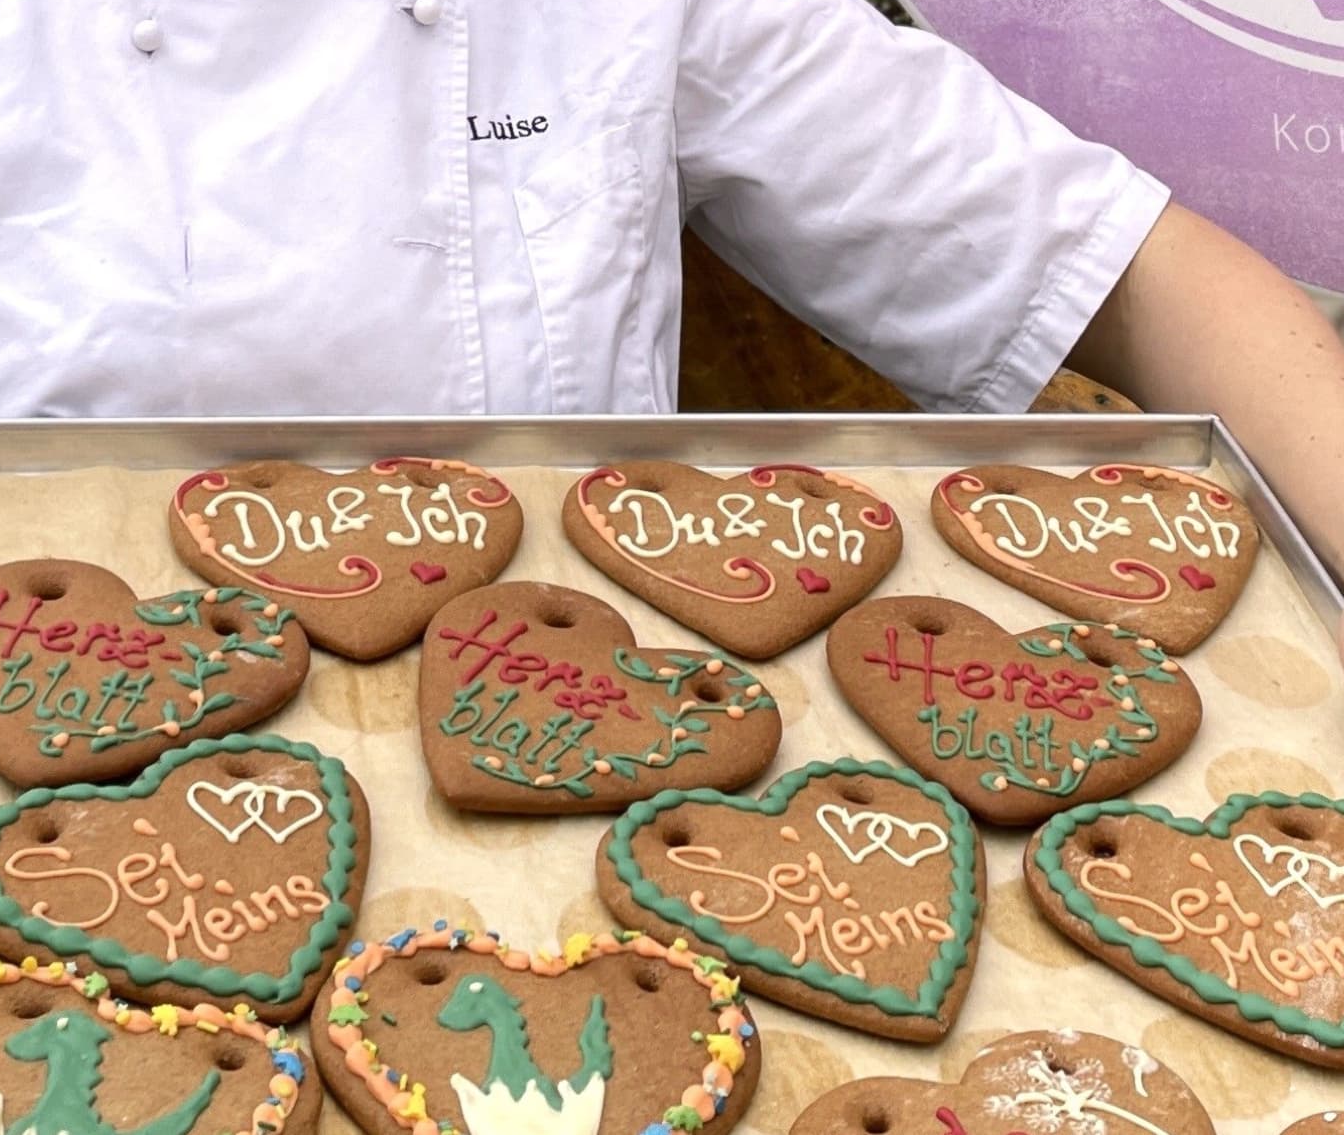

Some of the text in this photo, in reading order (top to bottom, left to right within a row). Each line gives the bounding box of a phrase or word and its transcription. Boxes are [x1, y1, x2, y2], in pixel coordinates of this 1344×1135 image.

[466, 114, 550, 141] Luise
[439, 679, 595, 773] blatt
[916, 704, 1063, 772] blatt
[4, 818, 205, 931] Sei
[146, 871, 332, 963] Meins
[665, 824, 852, 924] Sei
[1078, 855, 1262, 944] Sei
[782, 894, 955, 980] Meins
